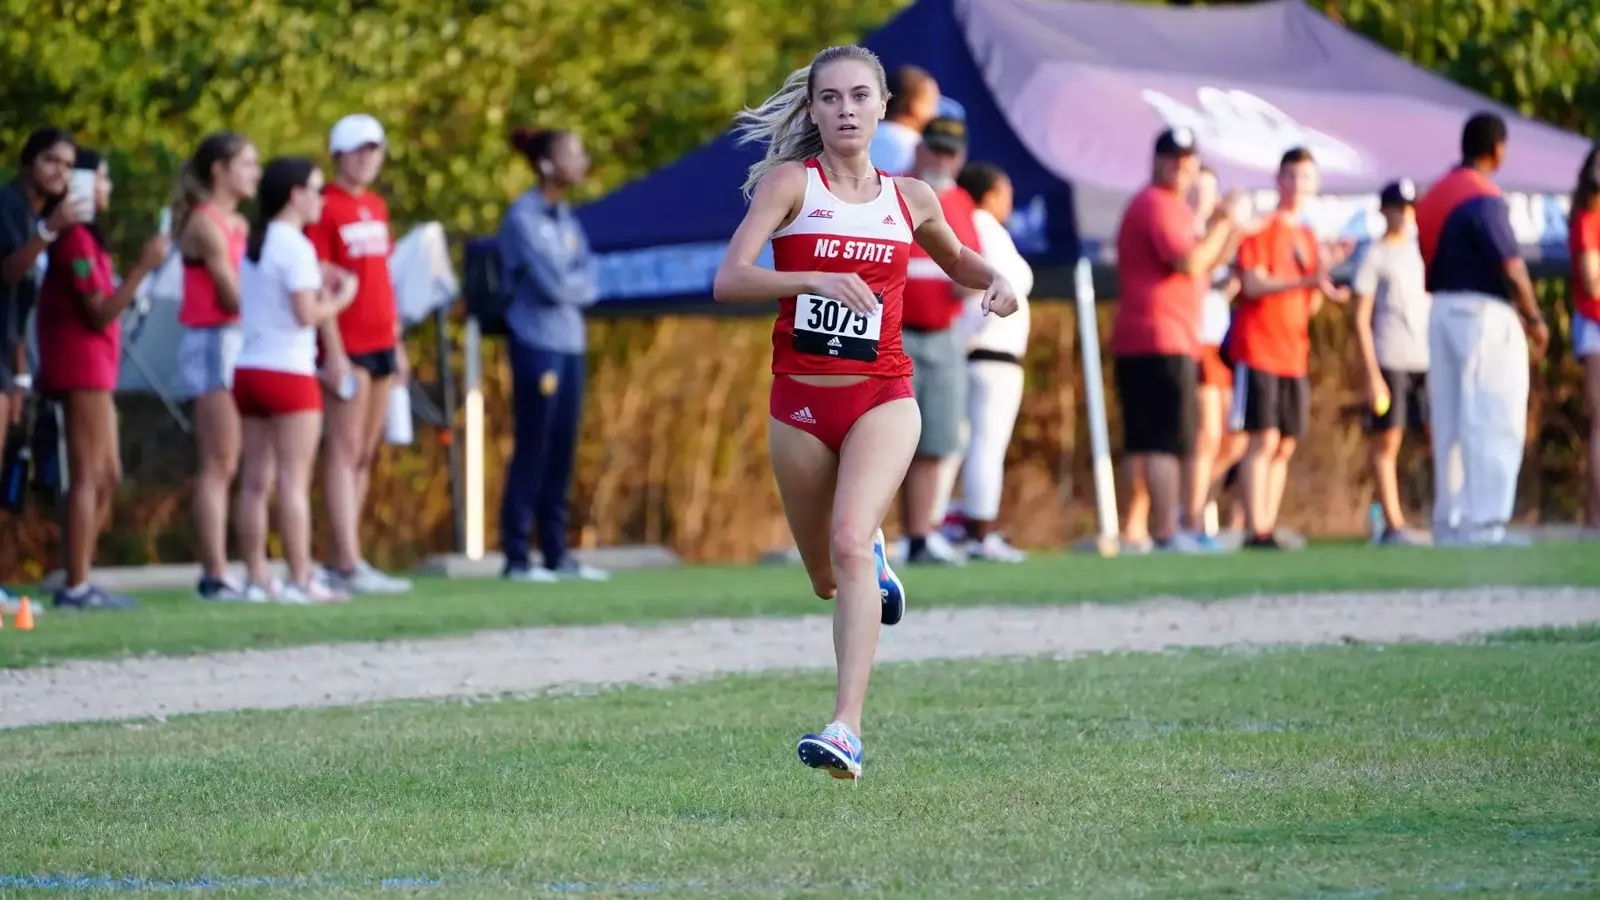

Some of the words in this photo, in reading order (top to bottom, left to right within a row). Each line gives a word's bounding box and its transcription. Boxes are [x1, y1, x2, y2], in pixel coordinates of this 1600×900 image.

[810, 209, 835, 217] ACC
[814, 239, 841, 258] NC
[843, 241, 896, 264] STATE
[807, 298, 868, 336] 3075
[790, 414, 817, 424] adidas
